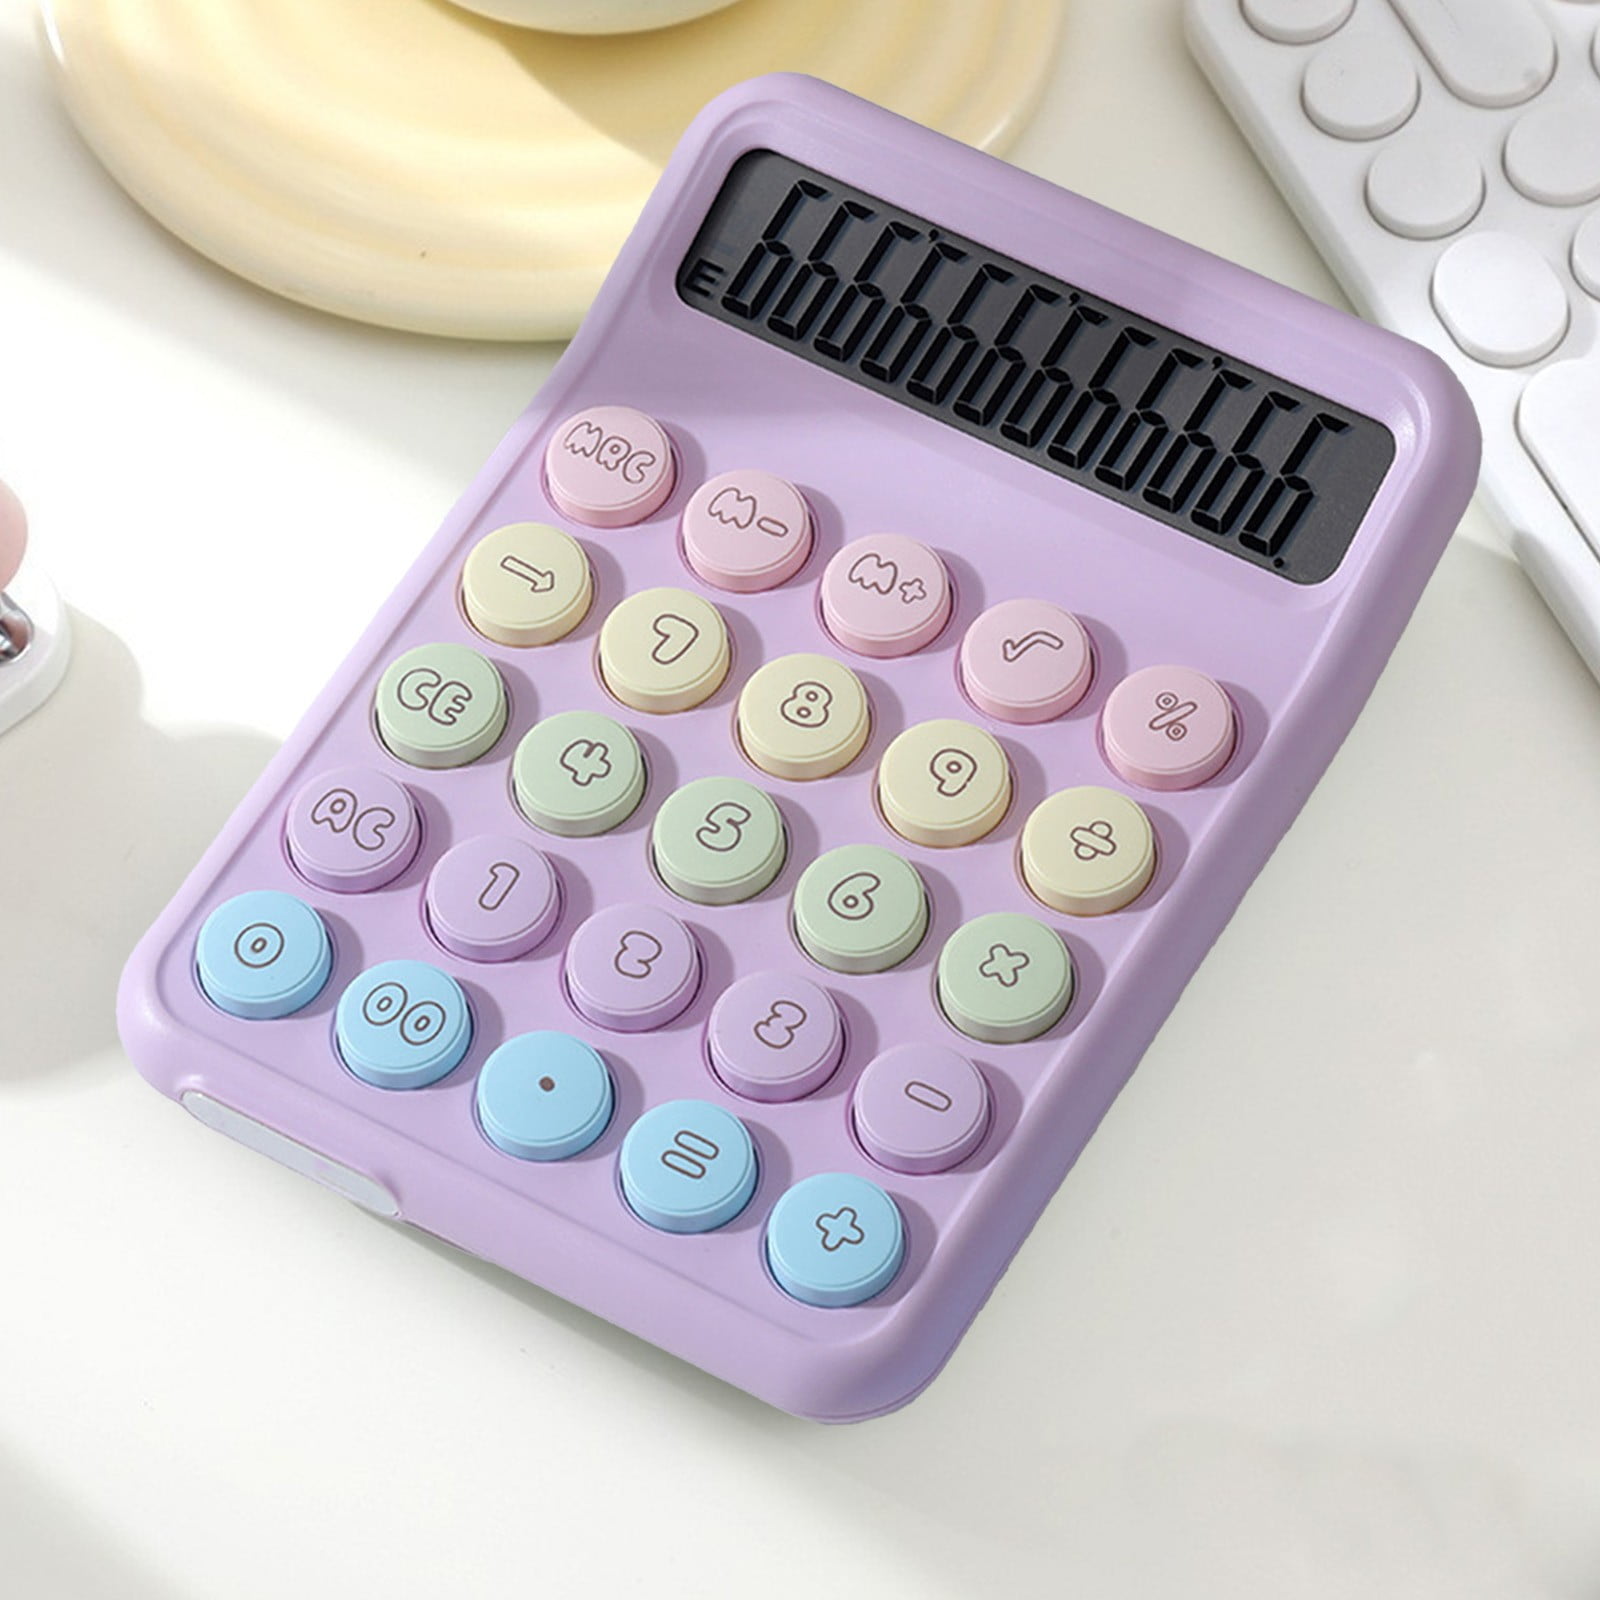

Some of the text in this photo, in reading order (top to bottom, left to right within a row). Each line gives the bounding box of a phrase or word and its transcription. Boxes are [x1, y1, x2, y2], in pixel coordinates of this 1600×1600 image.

[563, 421, 656, 484] MRC
[708, 487, 788, 537] M-
[848, 553, 927, 604] M+
[652, 614, 699, 665] 7
[397, 668, 473, 726] CE
[780, 681, 833, 728] 8
[1148, 691, 1198, 741] %
[560, 739, 612, 786] 4
[930, 748, 977, 797] 9
[311, 788, 396, 851] AC
[696, 802, 751, 852] 5
[478, 862, 520, 910] 1
[827, 872, 881, 920] 6
[234, 922, 284, 969] 0
[615, 931, 662, 979] 2
[362, 981, 446, 1046] 00
[754, 1000, 807, 1049] 3
